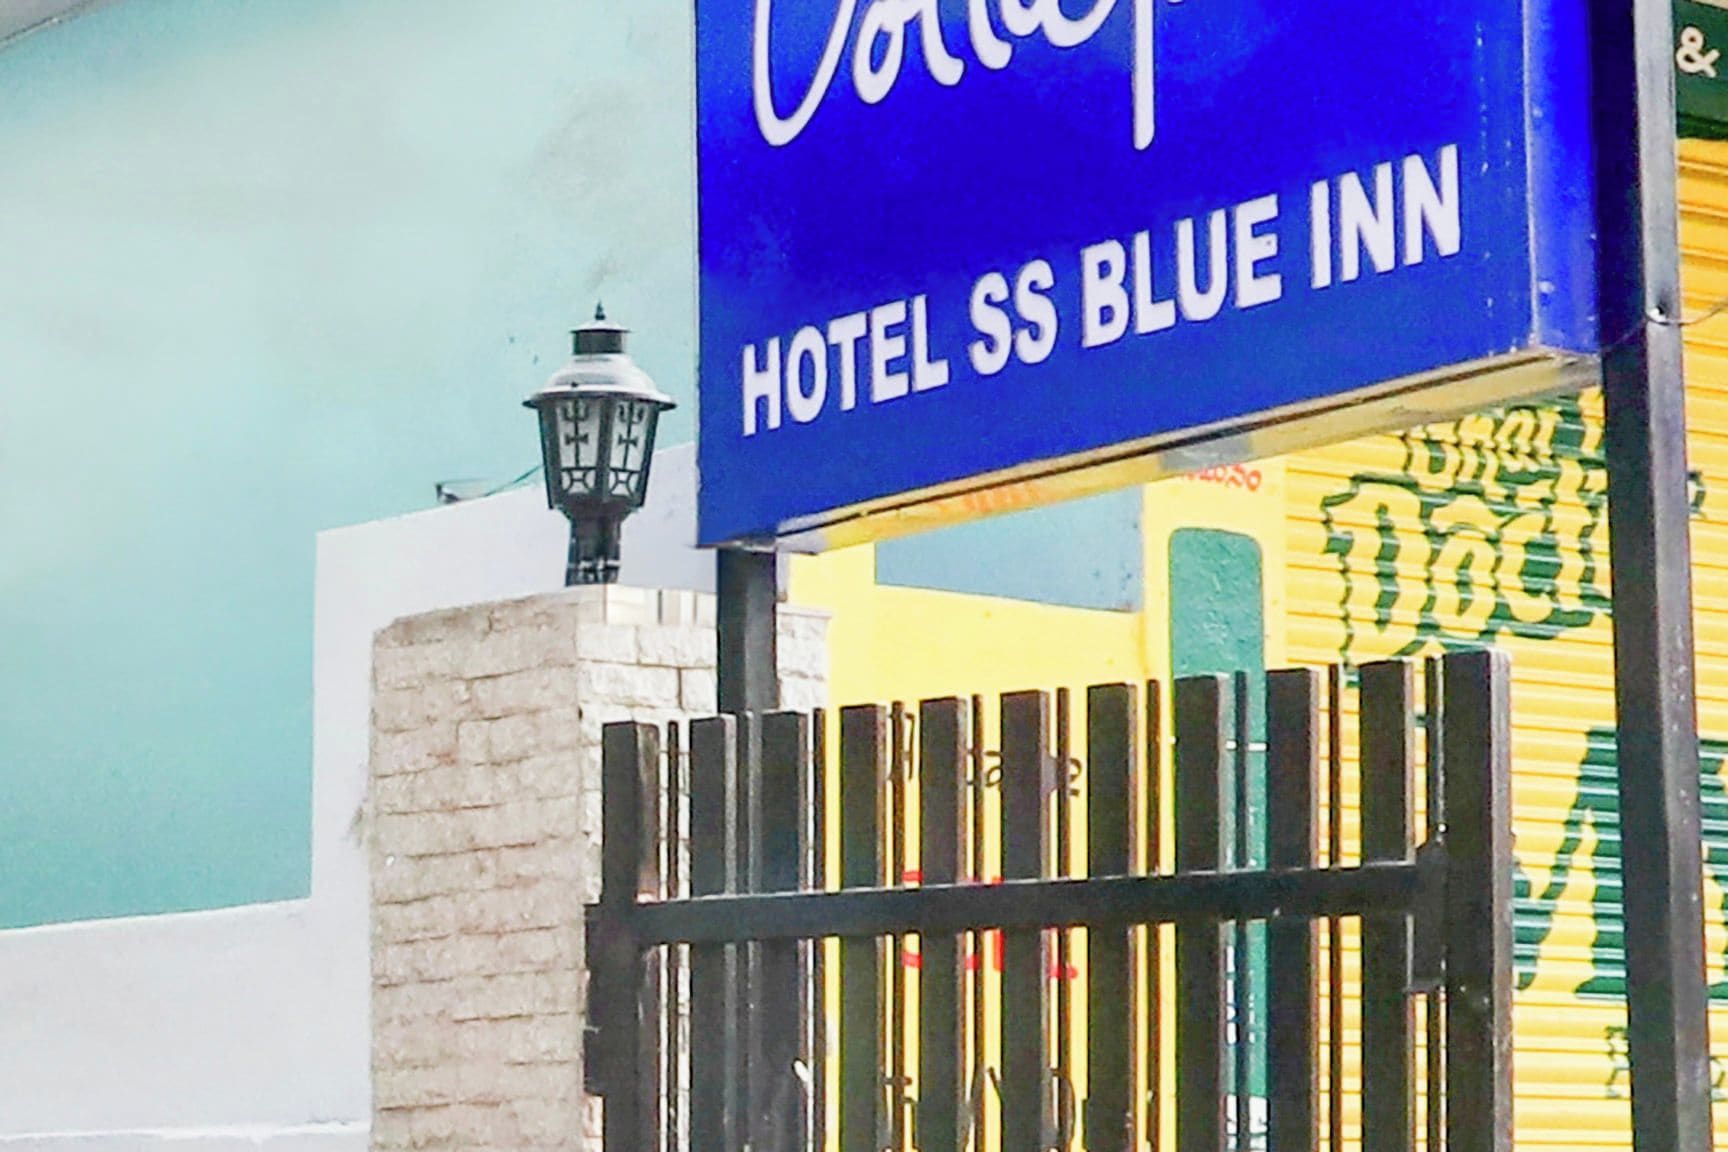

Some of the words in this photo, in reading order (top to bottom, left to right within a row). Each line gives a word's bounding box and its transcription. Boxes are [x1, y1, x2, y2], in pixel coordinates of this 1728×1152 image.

[1675, 26, 1720, 78] &
[742, 293, 950, 437] HOTEL
[969, 258, 1059, 376] SS
[1081, 194, 1283, 349] BLUE
[1310, 143, 1462, 290] INN
